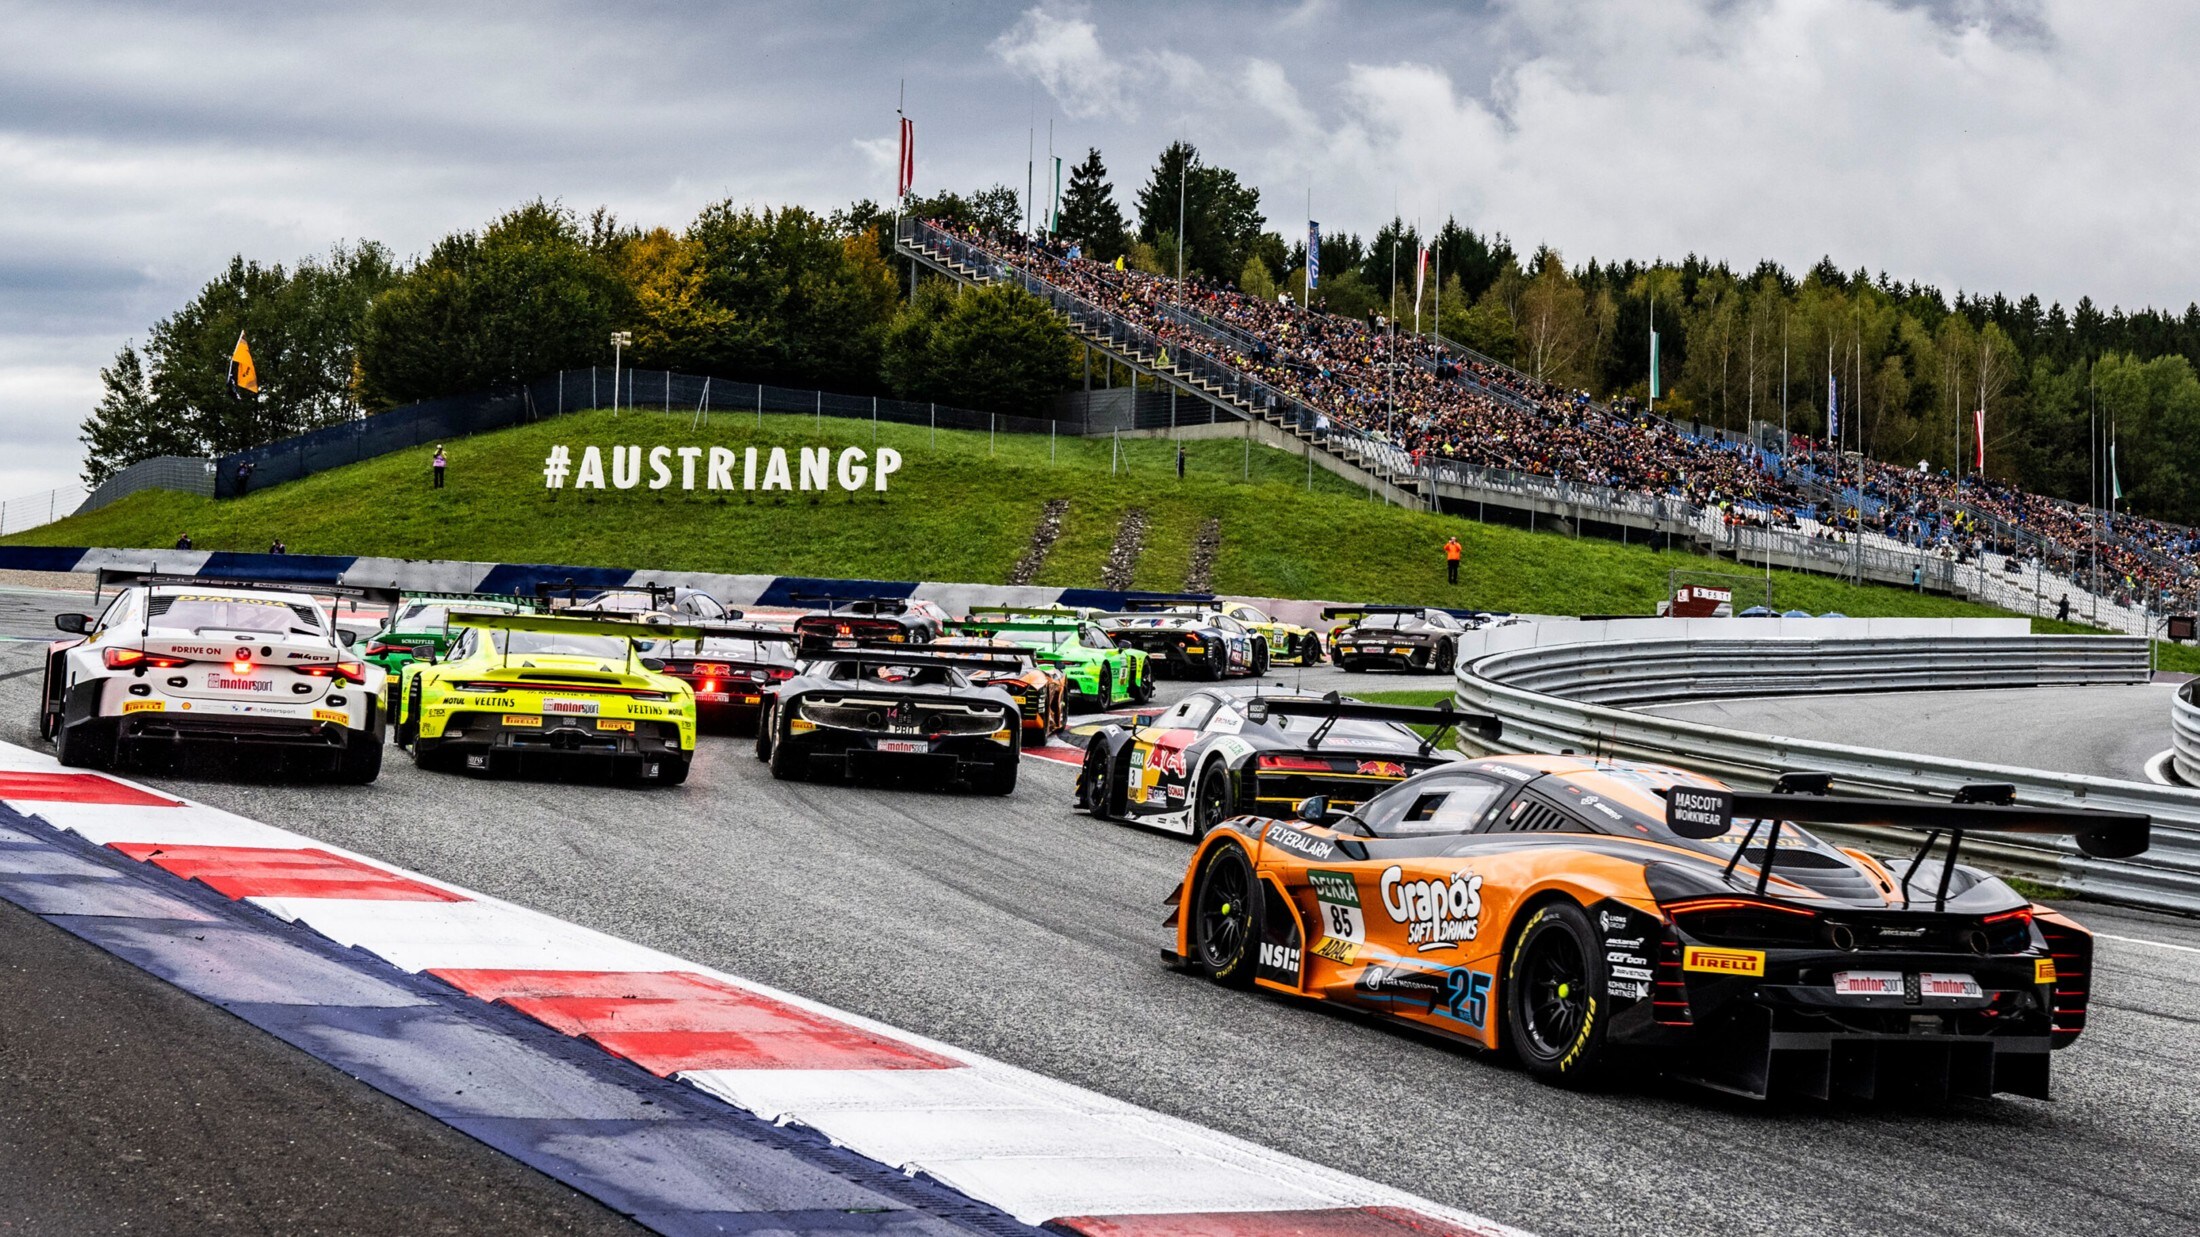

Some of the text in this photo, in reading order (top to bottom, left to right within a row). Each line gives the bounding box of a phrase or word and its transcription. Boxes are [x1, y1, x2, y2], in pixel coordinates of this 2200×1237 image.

[544, 445, 902, 492] #AUSTRIANGP
[137, 576, 362, 594] SCHUBERT MOTORSPORT
[178, 595, 288, 608] DTM 2024
[171, 645, 221, 655] #DRIVE ON
[683, 650, 741, 658] HYLO
[220, 679, 273, 692] motorsport
[125, 702, 162, 712] PIRELLI
[260, 707, 296, 715] Motorsport
[475, 697, 515, 707] VELTINS
[553, 702, 599, 714] motorsport
[627, 704, 663, 715] VELTINS
[886, 707, 898, 719] 14
[316, 710, 348, 725] PIRELLI
[506, 716, 538, 725] PIRELLI
[887, 741, 928, 753] motorsport
[1130, 770, 1136, 786] 3
[1168, 785, 1185, 798] SONAX
[1675, 808, 1721, 826] WORKWEAR
[1267, 826, 1334, 859] FLYERALARM
[1309, 876, 1359, 902] DEKRA
[1330, 905, 1353, 937] 85
[1609, 915, 1627, 923] LIONS
[1408, 919, 1478, 944] SOFT DRINKS
[1879, 928, 1926, 937] McLaren
[1606, 937, 1644, 946] McLaren
[1319, 939, 1353, 961] ADAC
[1690, 952, 1757, 971] PIRELLI
[1616, 969, 1648, 978] RAVENOL
[1849, 977, 1903, 993] motorsport
[1447, 967, 1493, 1030] 25
[1607, 988, 1636, 999] PARTNER
[1560, 995, 1597, 1073] PIRELLI
